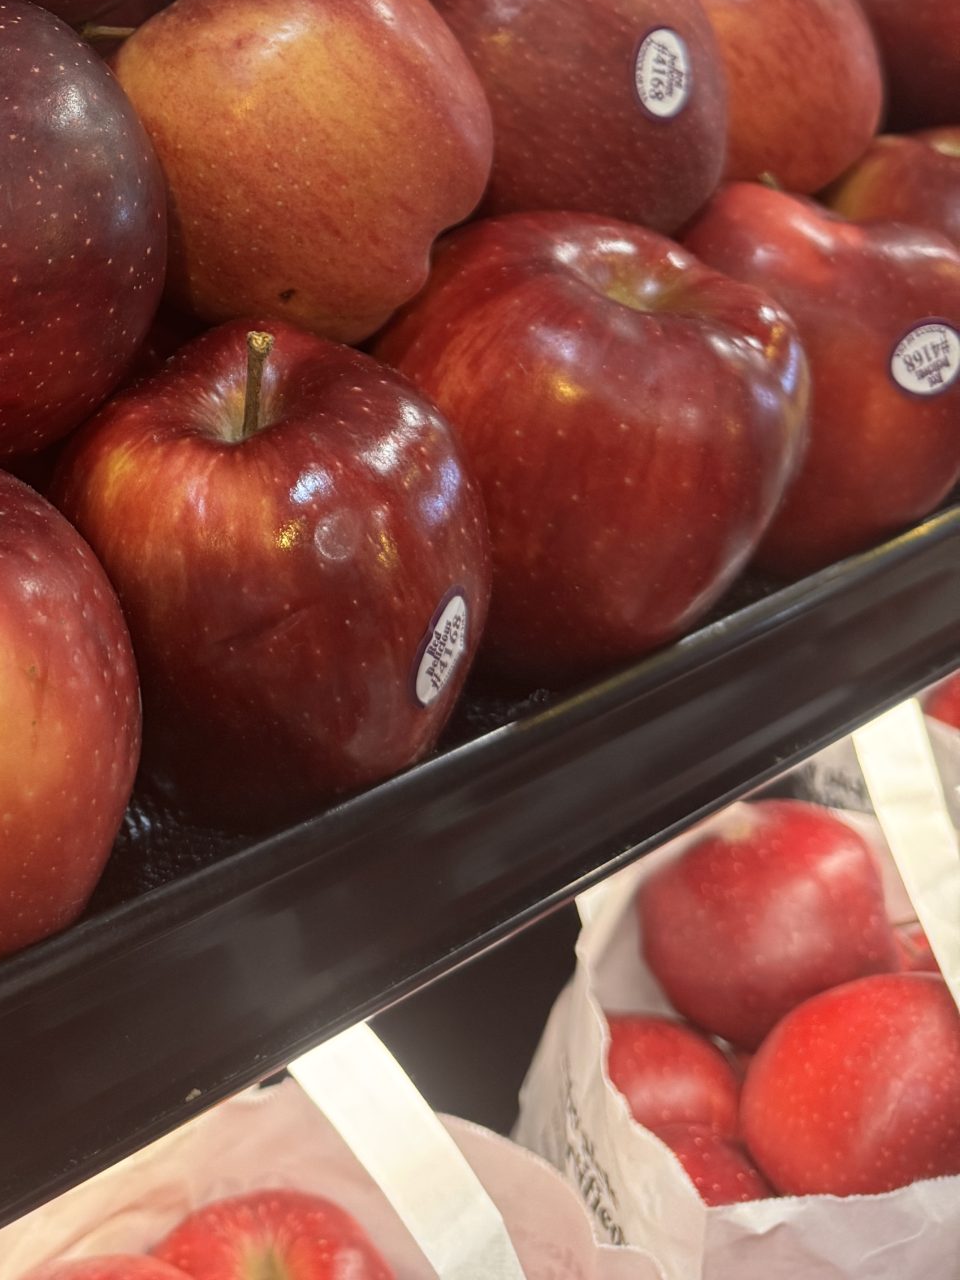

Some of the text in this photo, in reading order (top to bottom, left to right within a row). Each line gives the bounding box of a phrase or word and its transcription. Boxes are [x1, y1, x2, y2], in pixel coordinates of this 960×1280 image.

[648, 38, 669, 101] #4168
[903, 338, 950, 373] #4168
[425, 620, 452, 677] Delicious
[427, 631, 442, 656] Red
[431, 614, 461, 690] #4168
